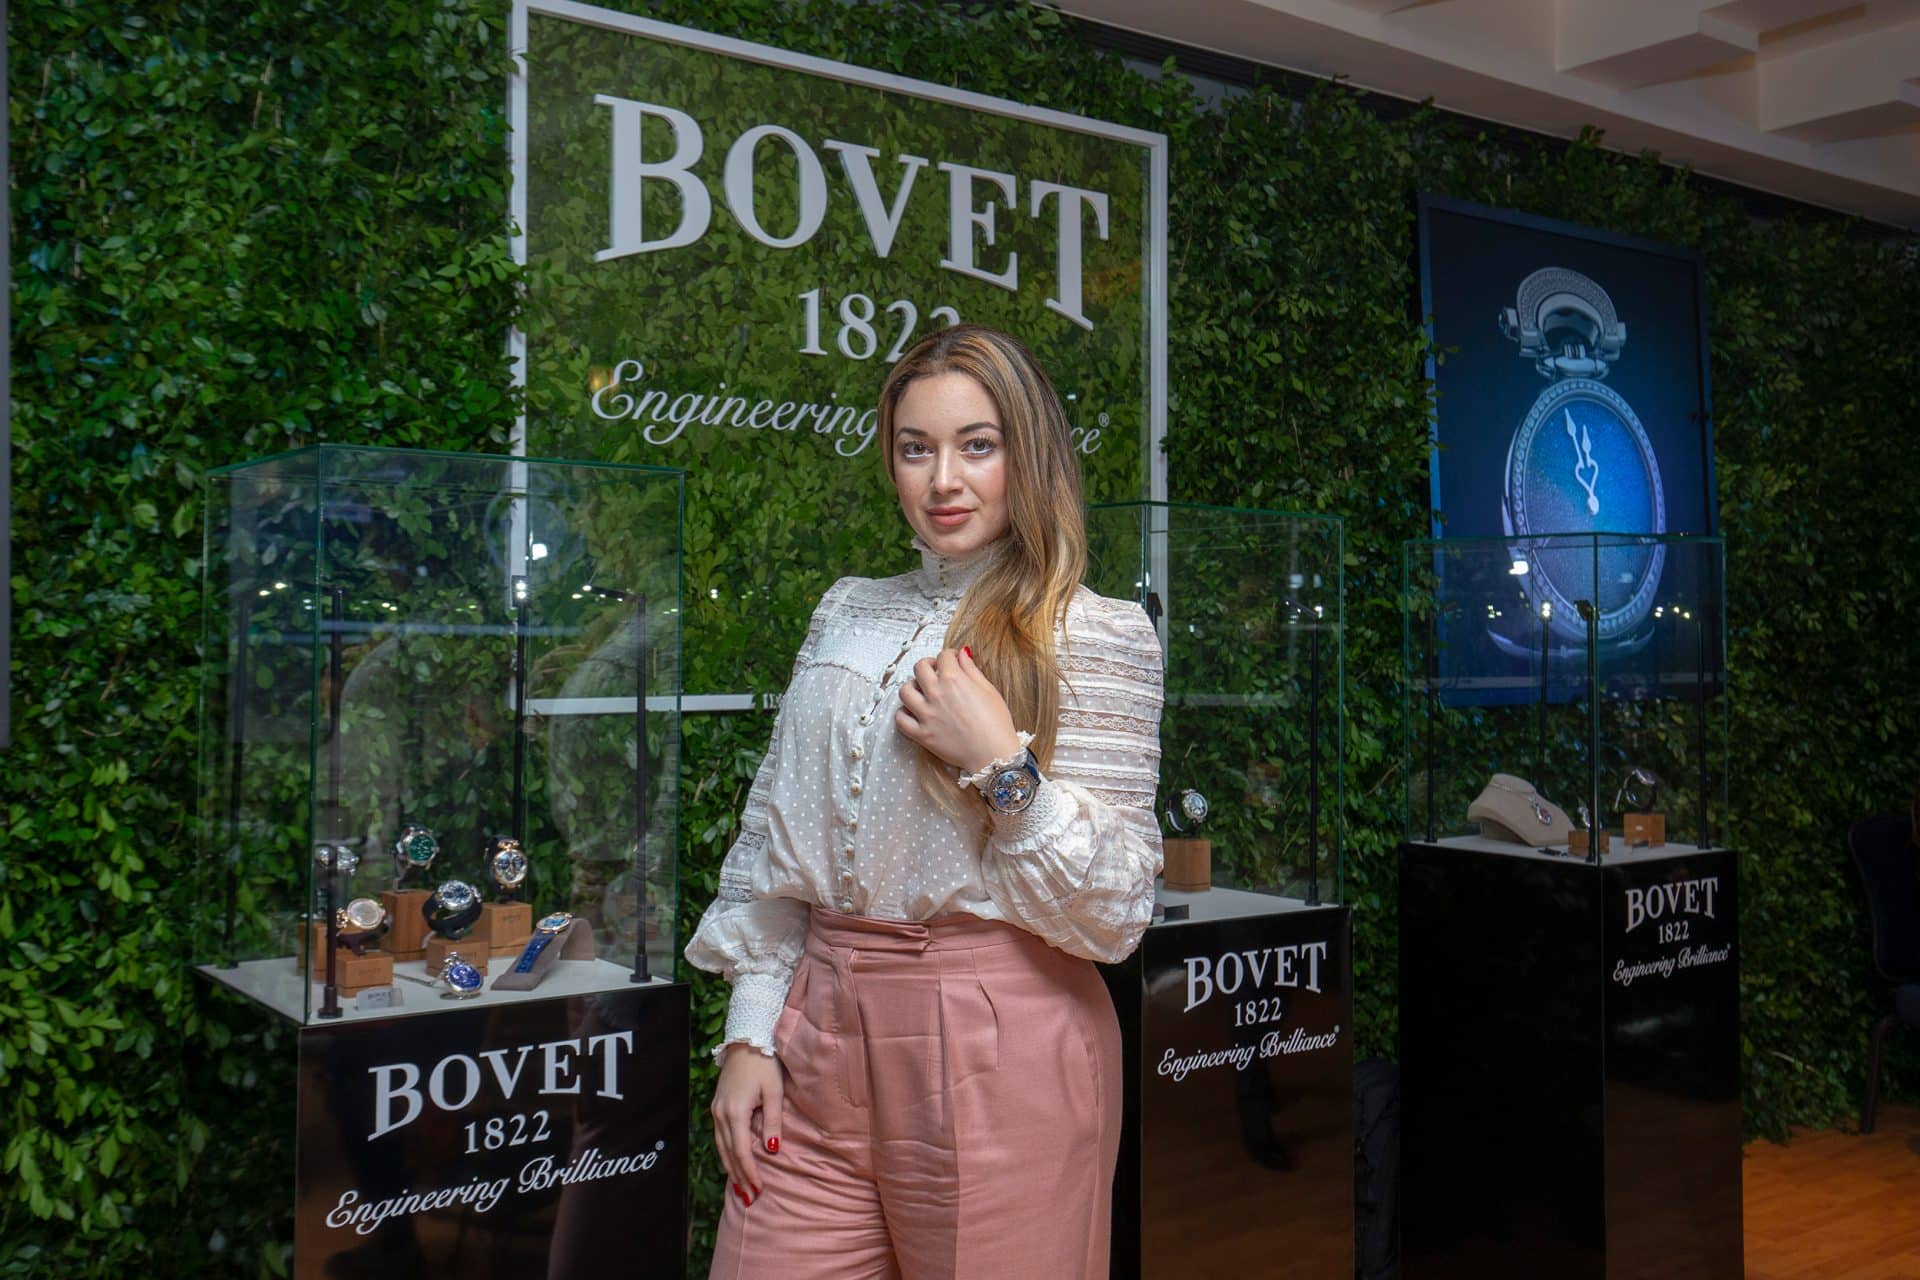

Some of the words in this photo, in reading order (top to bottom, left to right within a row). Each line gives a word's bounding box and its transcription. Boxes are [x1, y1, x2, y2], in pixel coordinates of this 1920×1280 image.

[594, 93, 1109, 331] BOVET
[1625, 877, 1718, 933] BOVET
[1658, 920, 1689, 944] 1822
[1183, 941, 1327, 1014] BOVET
[1612, 955, 1676, 986] Engineering
[1234, 996, 1282, 1027] 1822
[367, 1031, 633, 1142] BOVET
[1157, 1044, 1255, 1082] Engineering
[463, 1110, 552, 1155] 1822
[325, 1174, 510, 1235] Engineering
